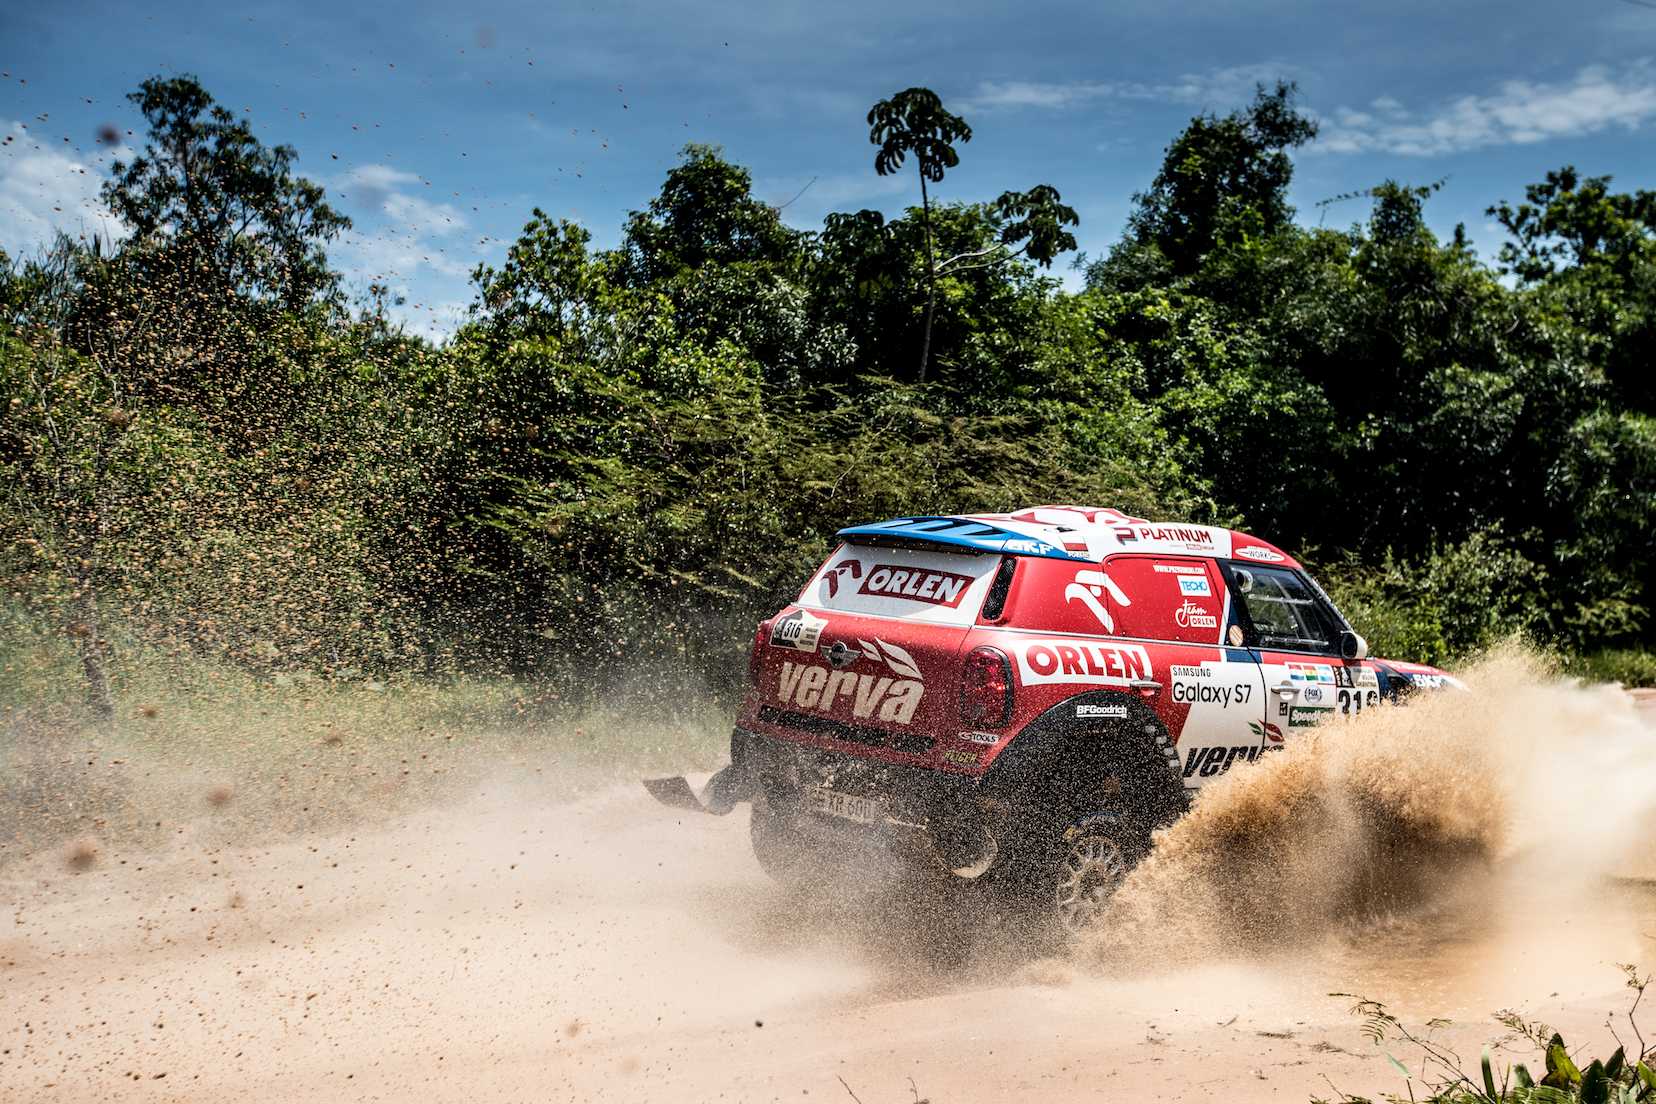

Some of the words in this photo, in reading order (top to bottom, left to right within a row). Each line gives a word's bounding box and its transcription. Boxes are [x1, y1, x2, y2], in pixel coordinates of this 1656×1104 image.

[1140, 527, 1213, 544] PLATINUM
[867, 567, 967, 604] ORLEN
[784, 621, 803, 639] 316
[1191, 617, 1216, 626] ORLEN
[1026, 644, 1149, 681] ORLEN
[1172, 666, 1212, 678] SAMSUNG
[777, 660, 926, 725] verva
[1173, 682, 1233, 708] Galaxy
[1235, 684, 1252, 704] S7
[1076, 704, 1128, 715] BFGoodrich
[1182, 745, 1284, 778] ver
